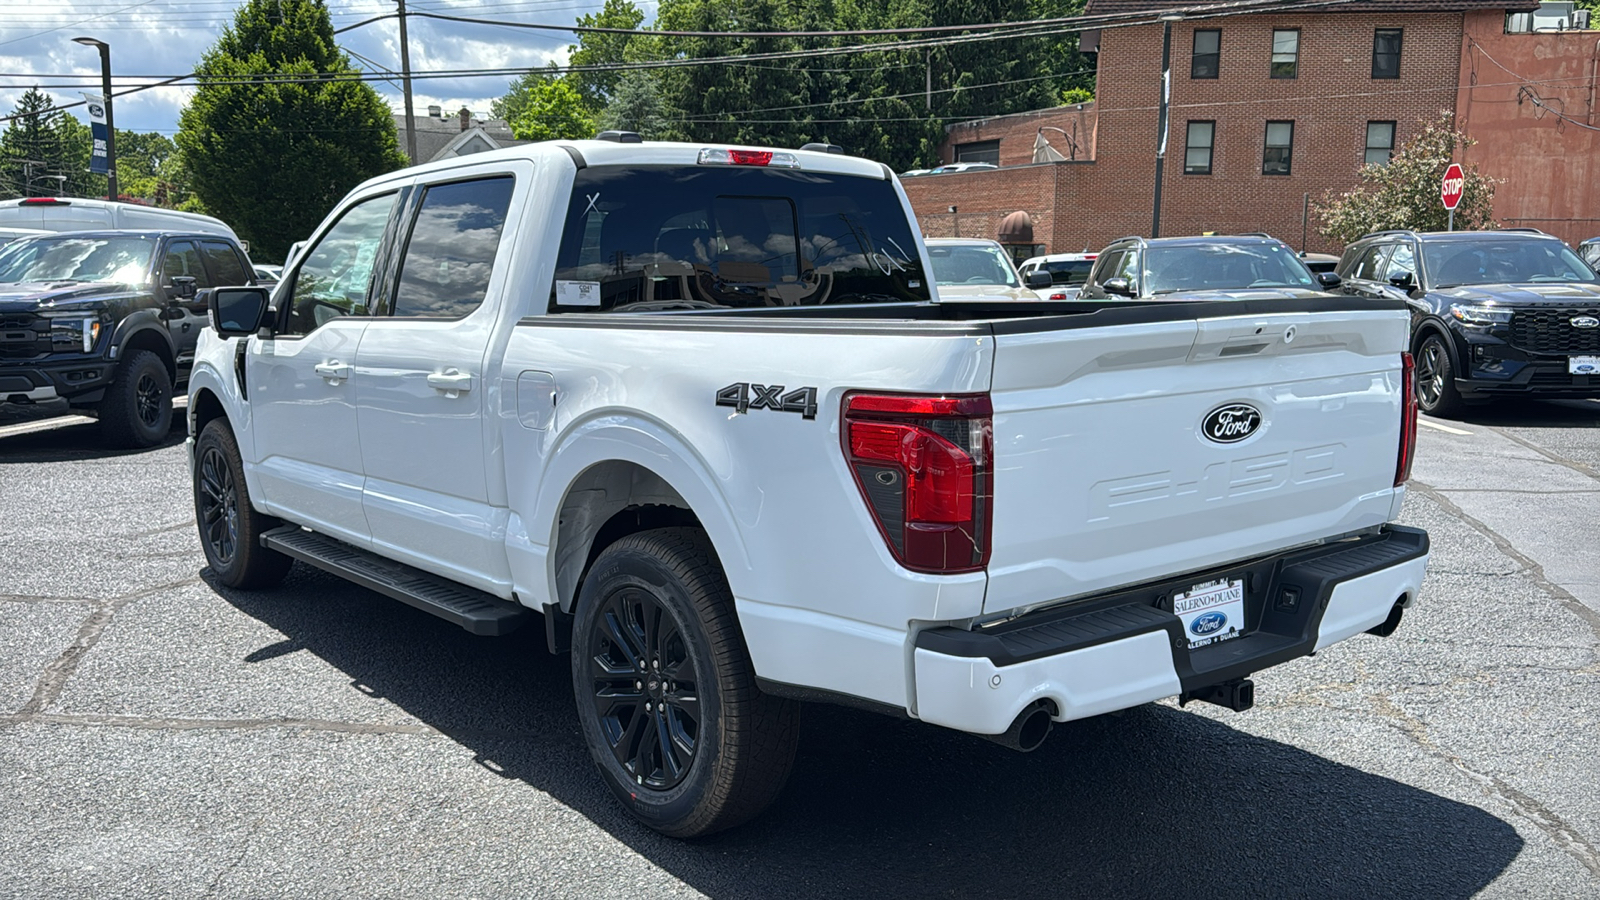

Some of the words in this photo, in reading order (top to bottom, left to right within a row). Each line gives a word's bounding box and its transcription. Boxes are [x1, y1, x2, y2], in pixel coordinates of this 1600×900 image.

[1443, 178, 1462, 195] STOP
[1214, 410, 1253, 437] Ford
[1197, 615, 1220, 633] Ford
[1220, 631, 1240, 641] DUANE
